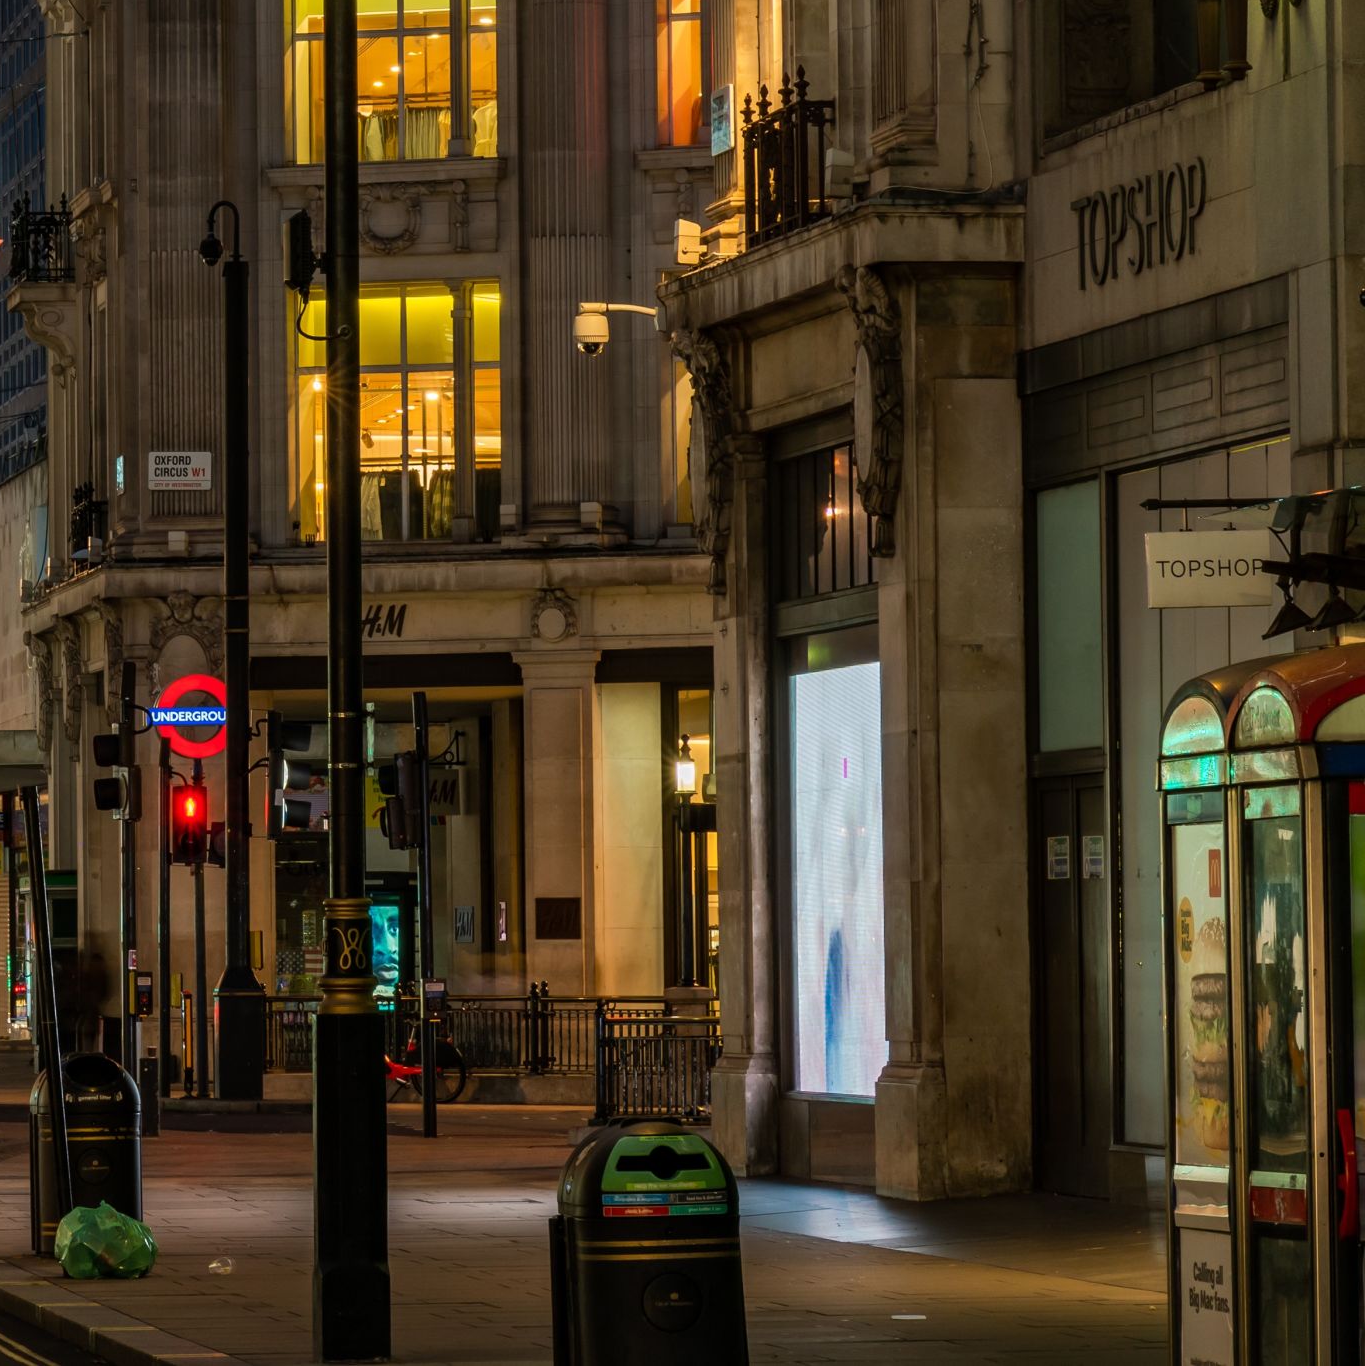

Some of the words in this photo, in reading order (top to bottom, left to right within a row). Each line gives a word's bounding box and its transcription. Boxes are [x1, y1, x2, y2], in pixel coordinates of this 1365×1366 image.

[1070, 155, 1207, 291] TOPSHOP
[154, 455, 192, 466] OXFORD
[154, 467, 189, 477] CIRCUS
[191, 467, 206, 477] W1
[1155, 558, 1264, 578] TOPSHOP
[361, 603, 407, 638] H&M
[152, 710, 226, 722] UNDERGROU
[1193, 1261, 1215, 1290] Calling
[1215, 1265, 1224, 1285] all
[1189, 1286, 1200, 1314] Big
[1200, 1290, 1214, 1311] Mac
